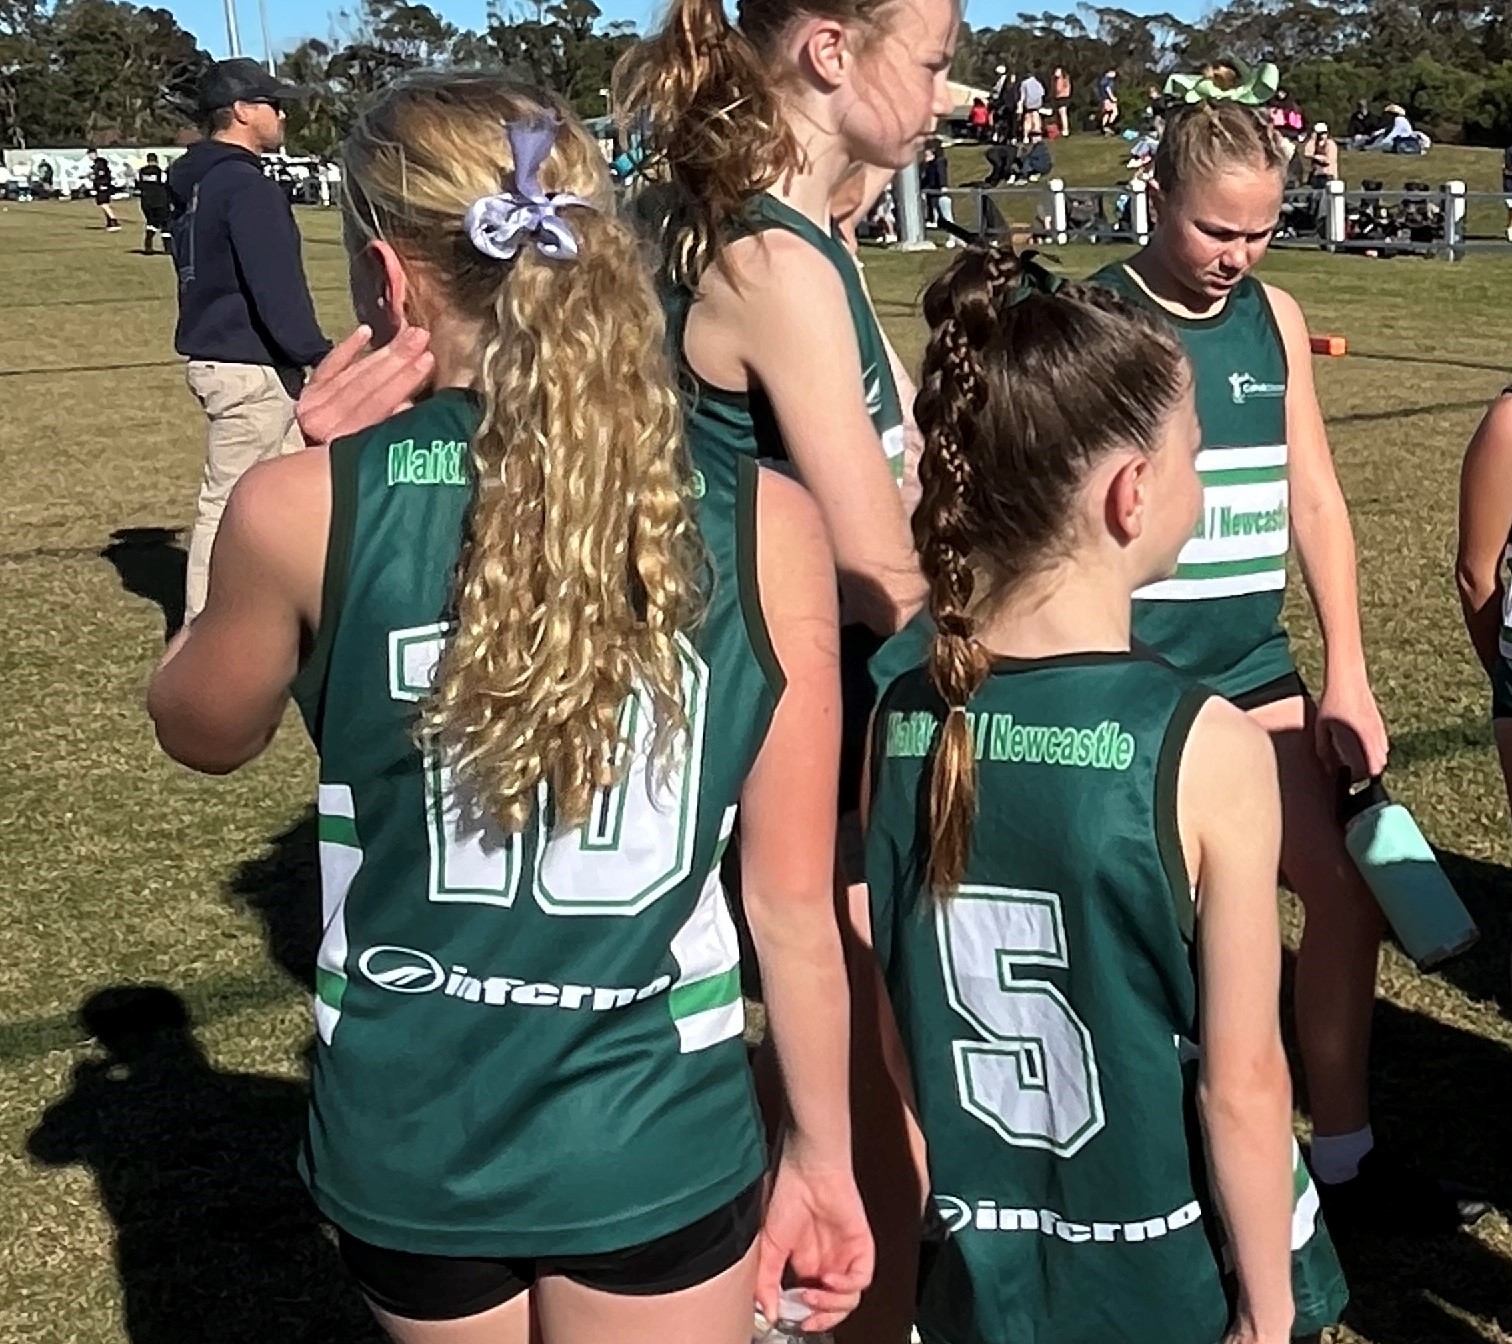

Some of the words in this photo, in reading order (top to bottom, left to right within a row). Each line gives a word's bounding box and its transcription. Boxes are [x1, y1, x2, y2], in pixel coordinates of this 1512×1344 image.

[388, 439, 468, 486] Maitl
[990, 714, 1134, 770] Newcastle
[444, 965, 672, 1011] inferno
[935, 884, 1105, 1157] 5
[975, 1200, 1201, 1242] inferno
